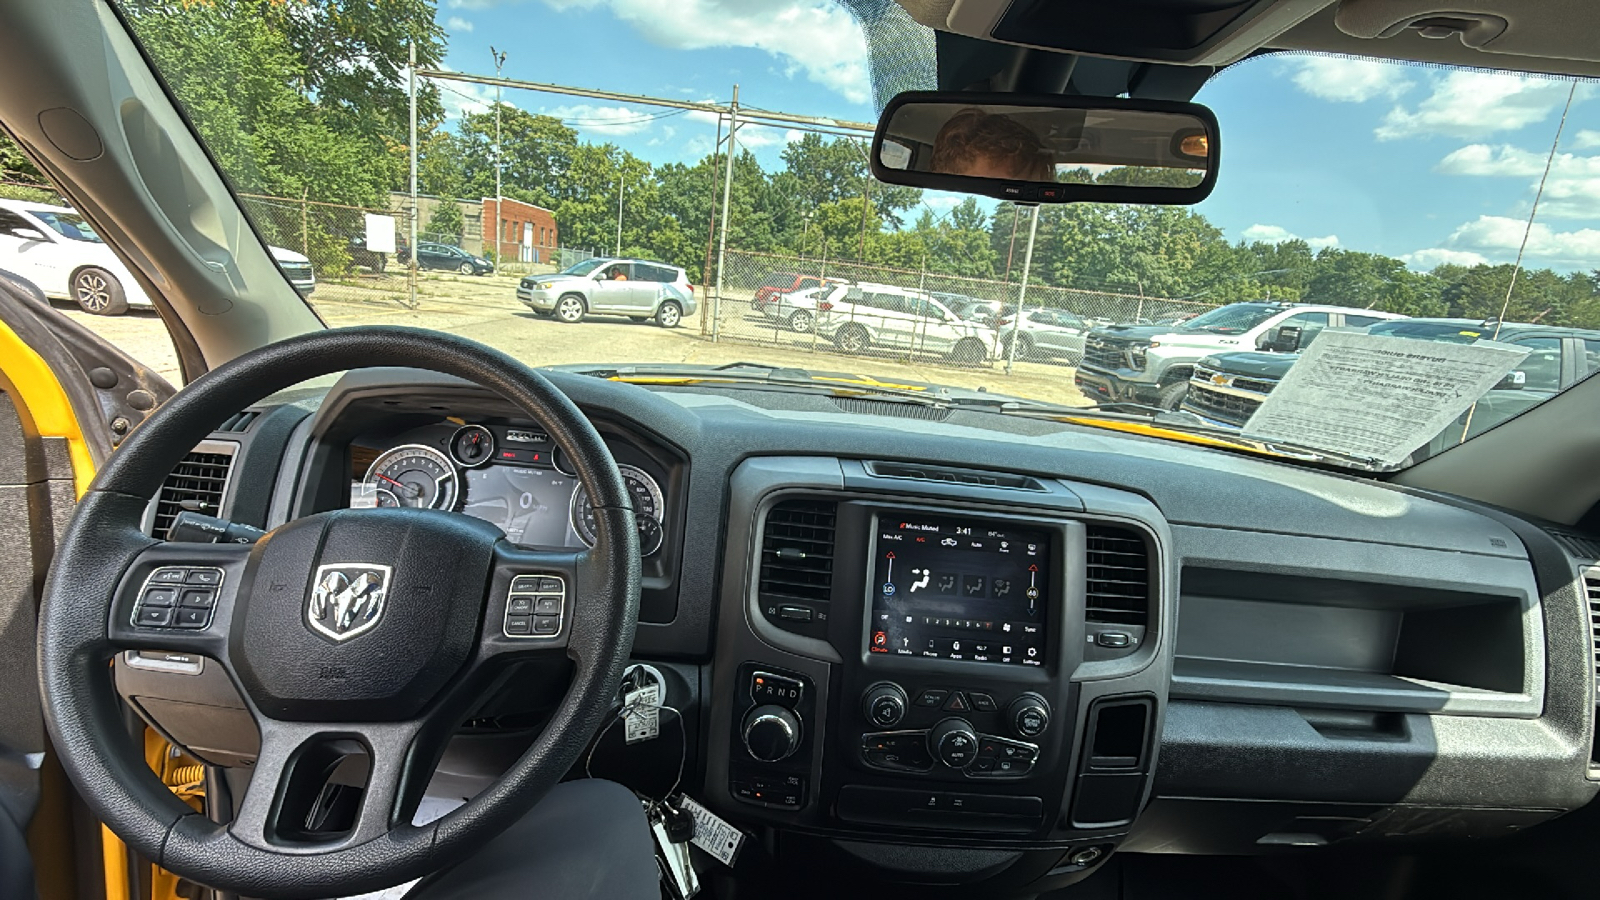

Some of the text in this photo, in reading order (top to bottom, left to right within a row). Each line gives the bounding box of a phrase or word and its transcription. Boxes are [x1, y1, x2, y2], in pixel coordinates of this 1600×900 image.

[519, 492, 532, 509] 0
[956, 526, 971, 536] 3:41
[756, 684, 797, 698] P R N D
